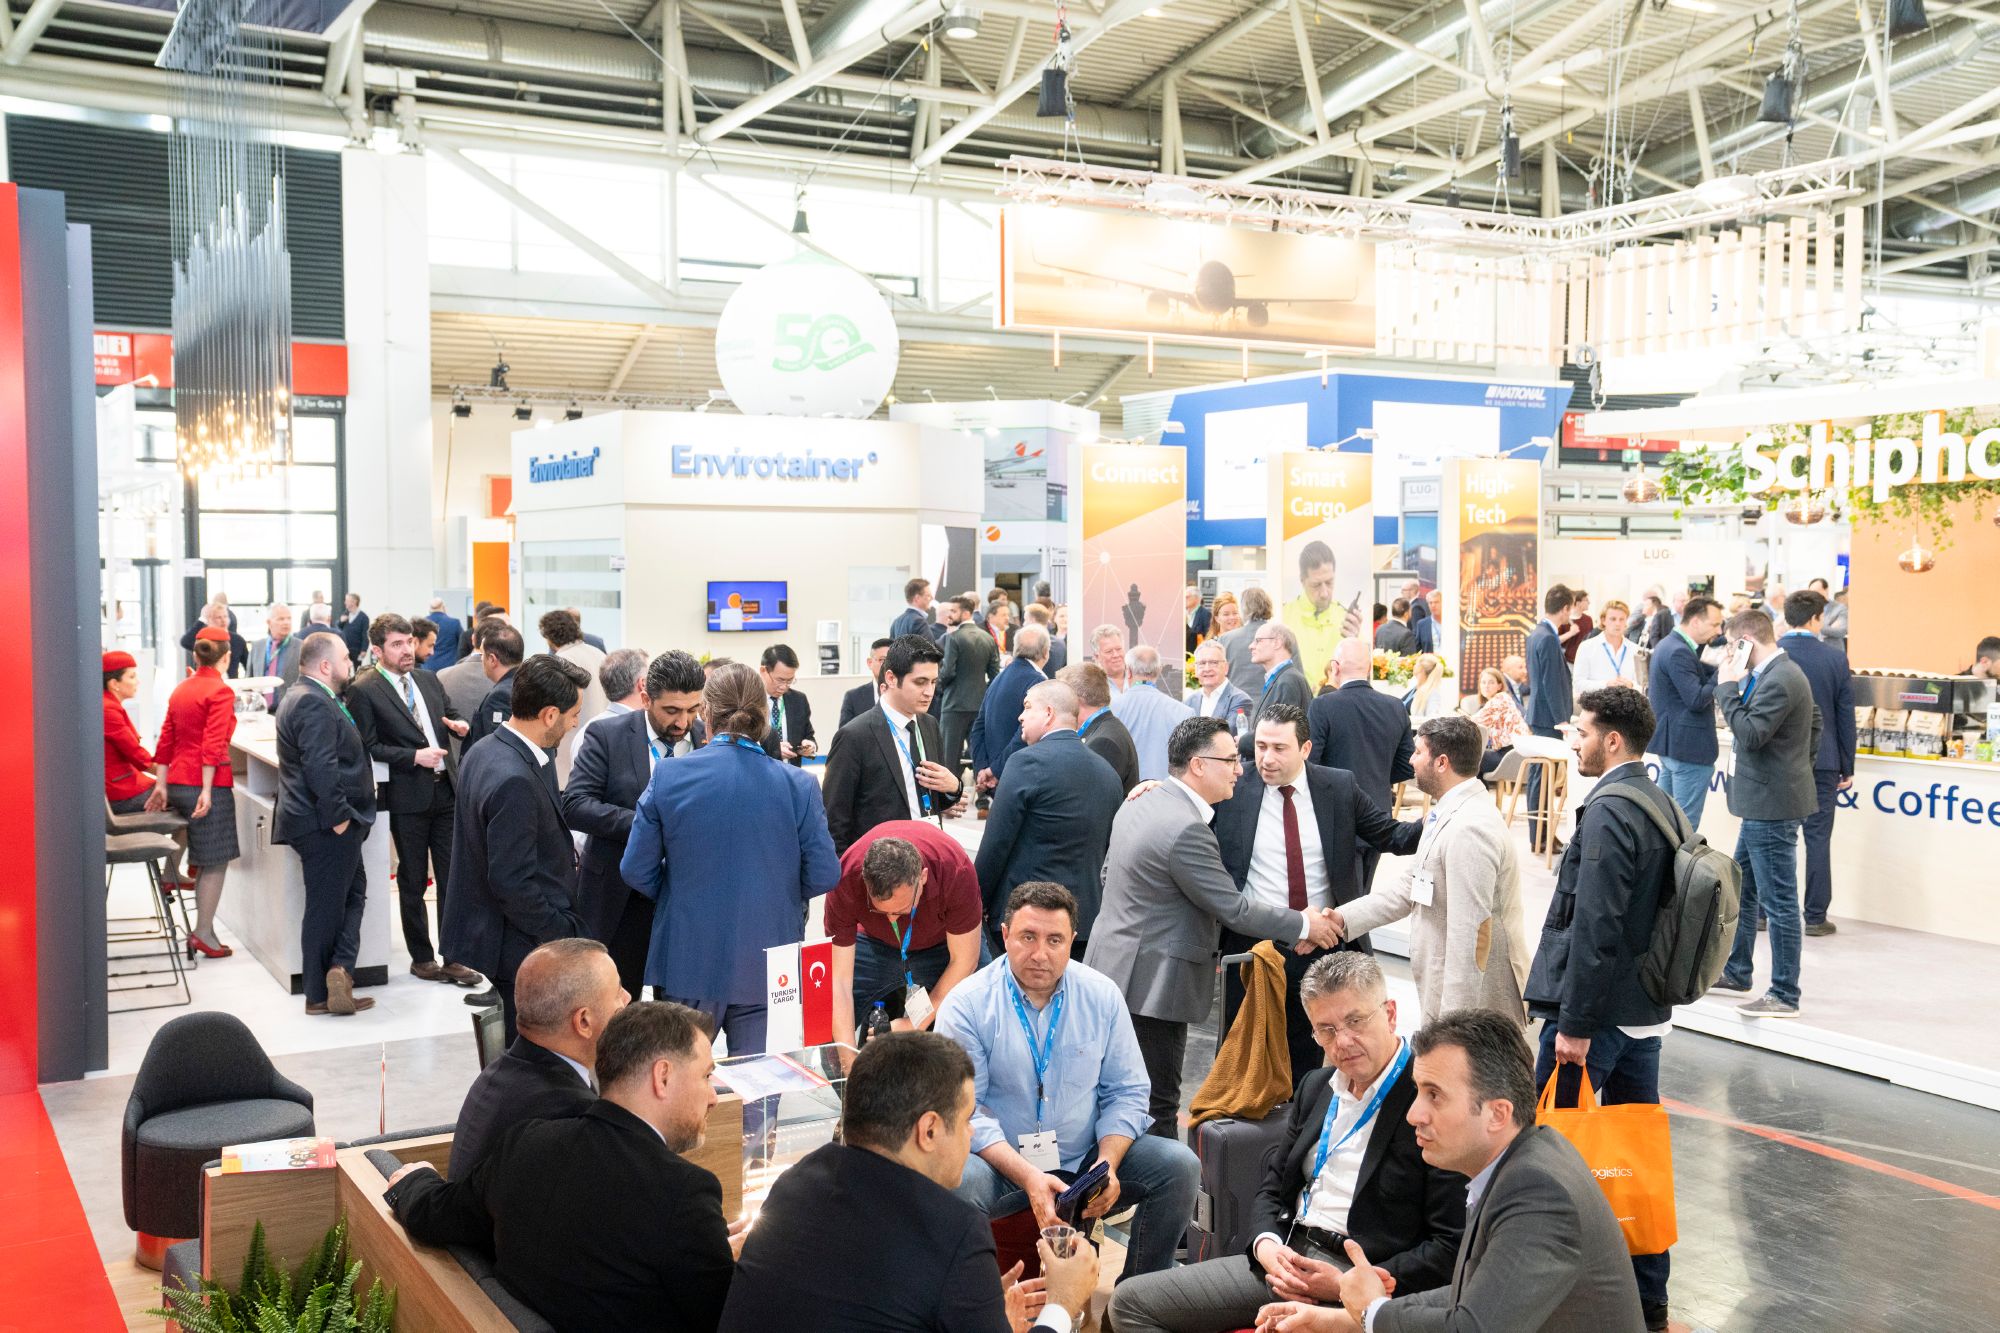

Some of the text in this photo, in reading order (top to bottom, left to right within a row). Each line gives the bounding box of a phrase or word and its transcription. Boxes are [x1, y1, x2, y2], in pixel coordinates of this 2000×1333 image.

[771, 313, 874, 372] 50
[1496, 384, 1546, 400] NATIONAL
[1091, 461, 1179, 484] Connect
[1290, 467, 1347, 488] Smart
[1410, 484, 1432, 494] LUG
[1465, 472, 1515, 499] High-
[1291, 496, 1346, 523] Cargo
[1465, 503, 1506, 524] Tech
[1643, 548, 1670, 559] LUG
[1873, 780, 2000, 828] Coffee
[771, 988, 797, 998] TURKISH
[774, 995, 794, 1004] CARGO
[1591, 1167, 1632, 1179] ogistics
